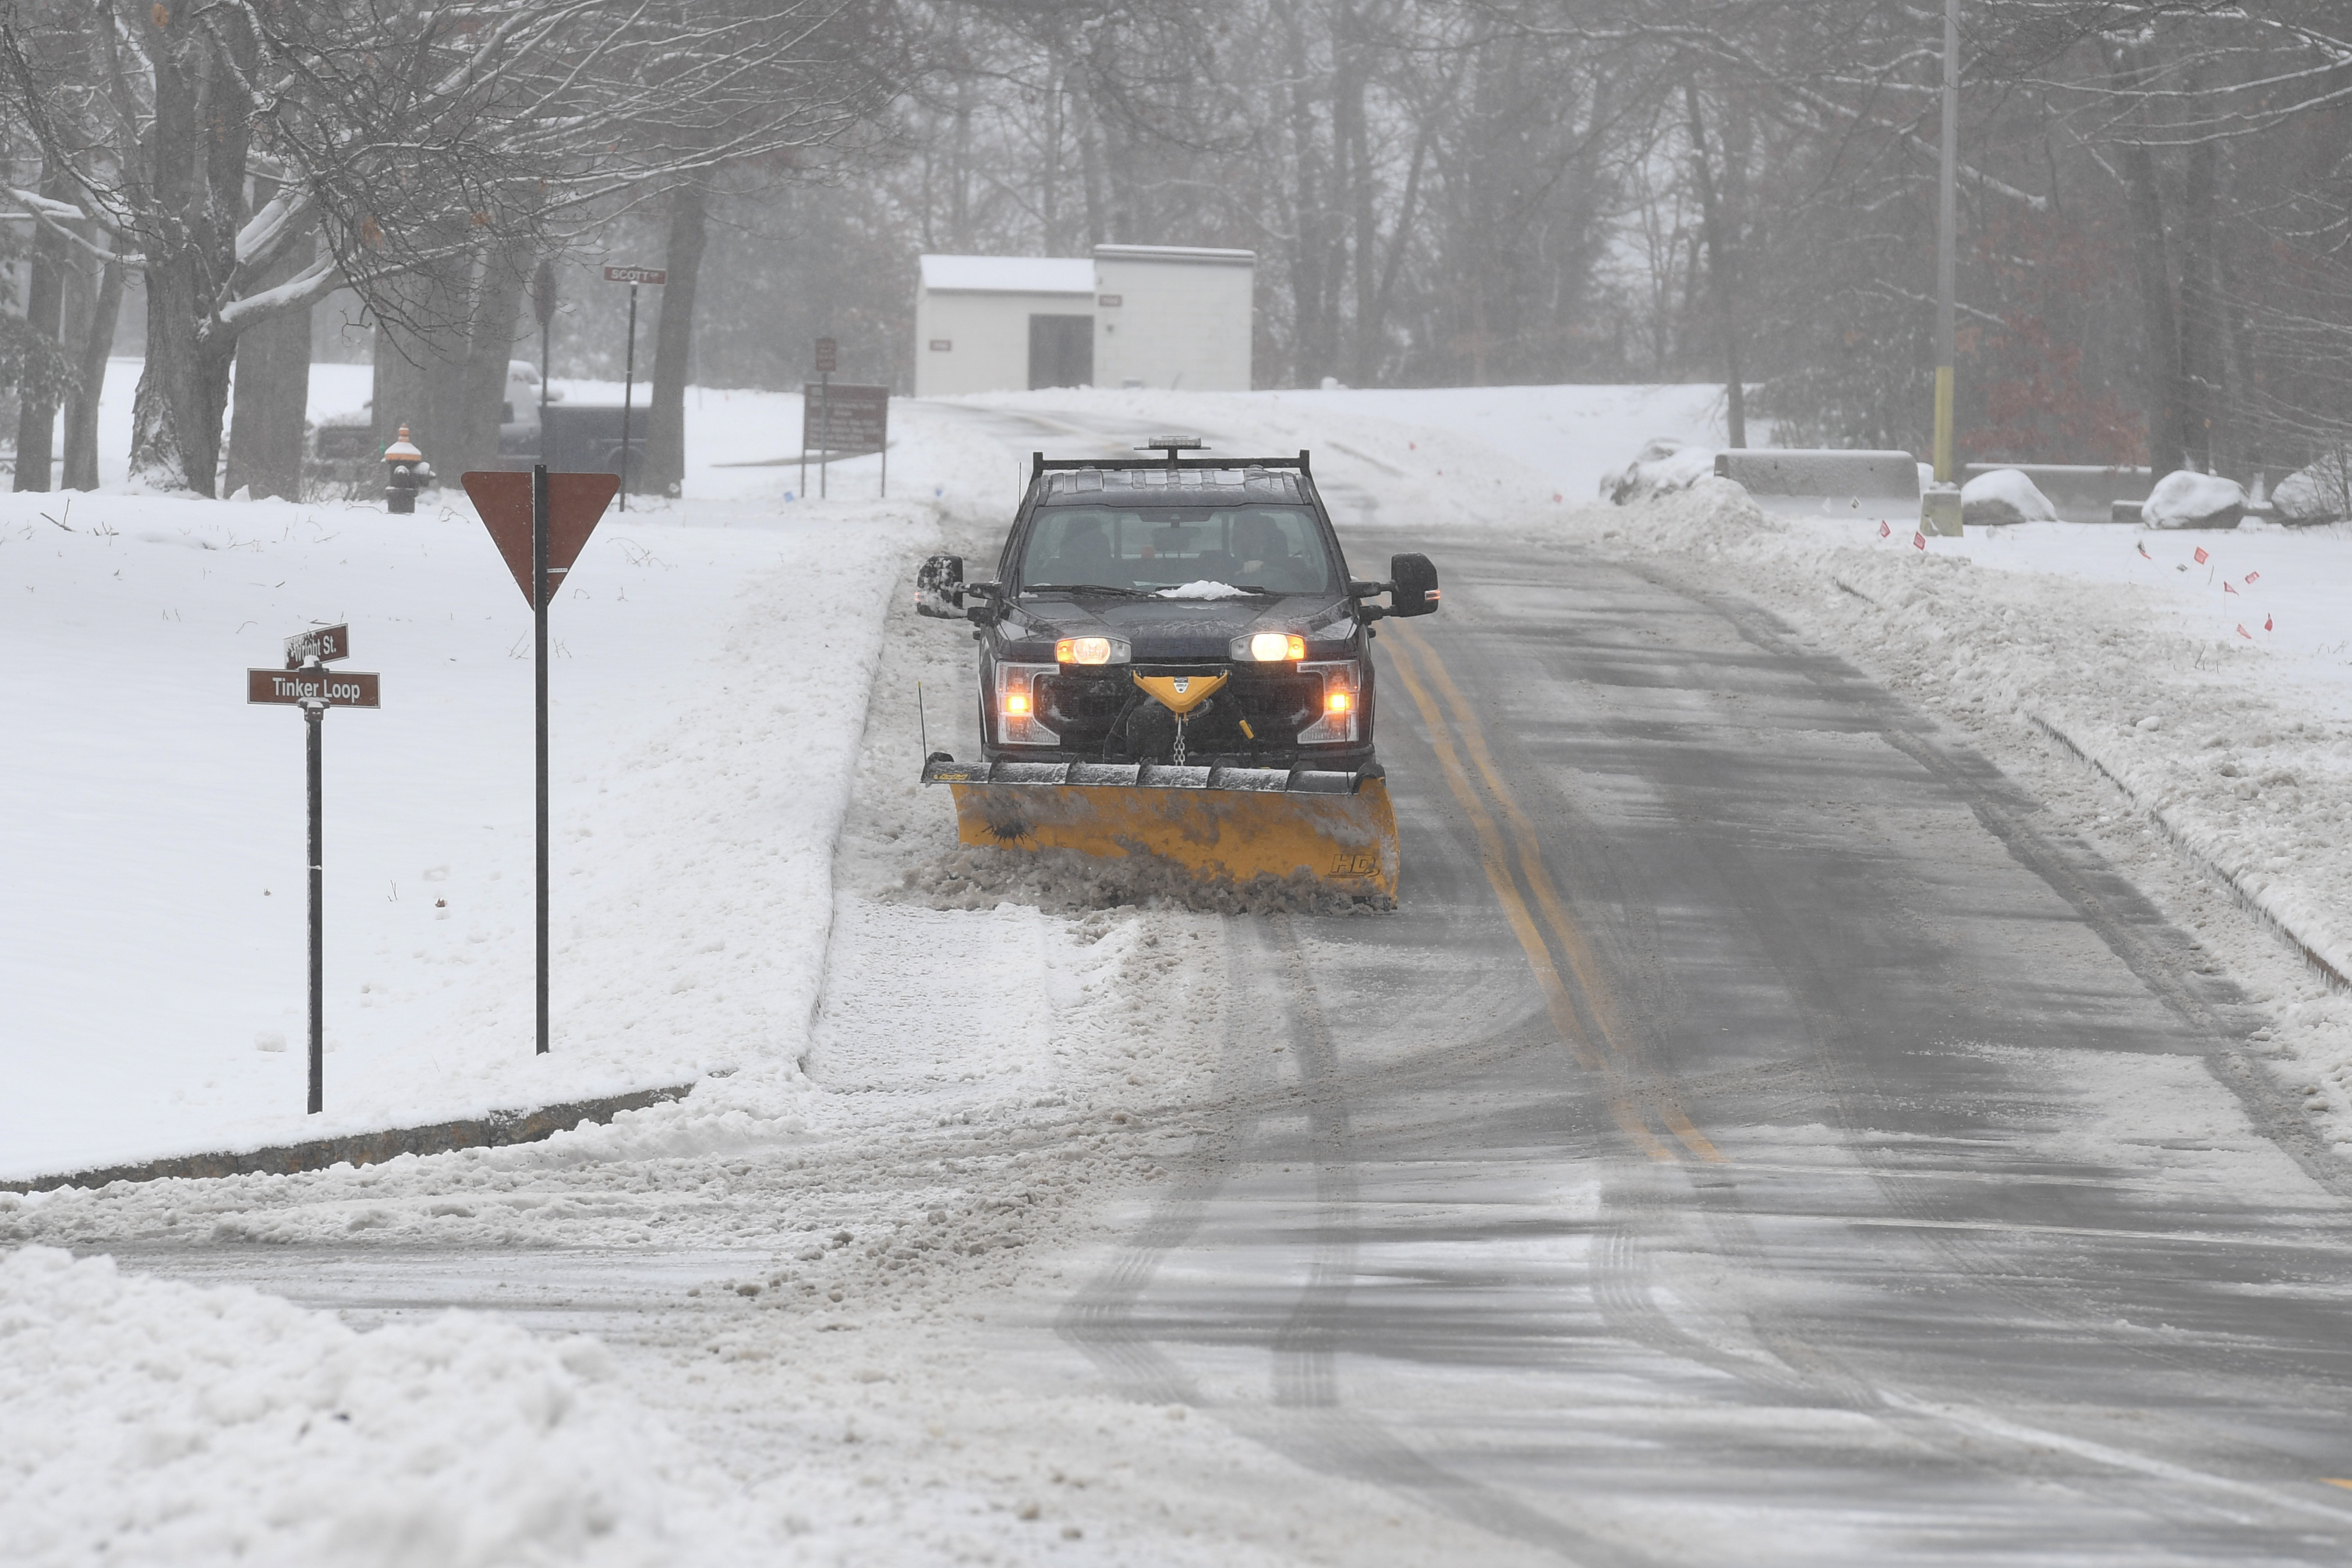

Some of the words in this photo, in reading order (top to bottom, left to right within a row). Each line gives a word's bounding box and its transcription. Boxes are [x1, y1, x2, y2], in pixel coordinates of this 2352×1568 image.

[611, 269, 648, 281] SCOTT
[323, 635, 337, 655] St.
[272, 677, 319, 697] Tinker
[323, 679, 360, 703] Loop
